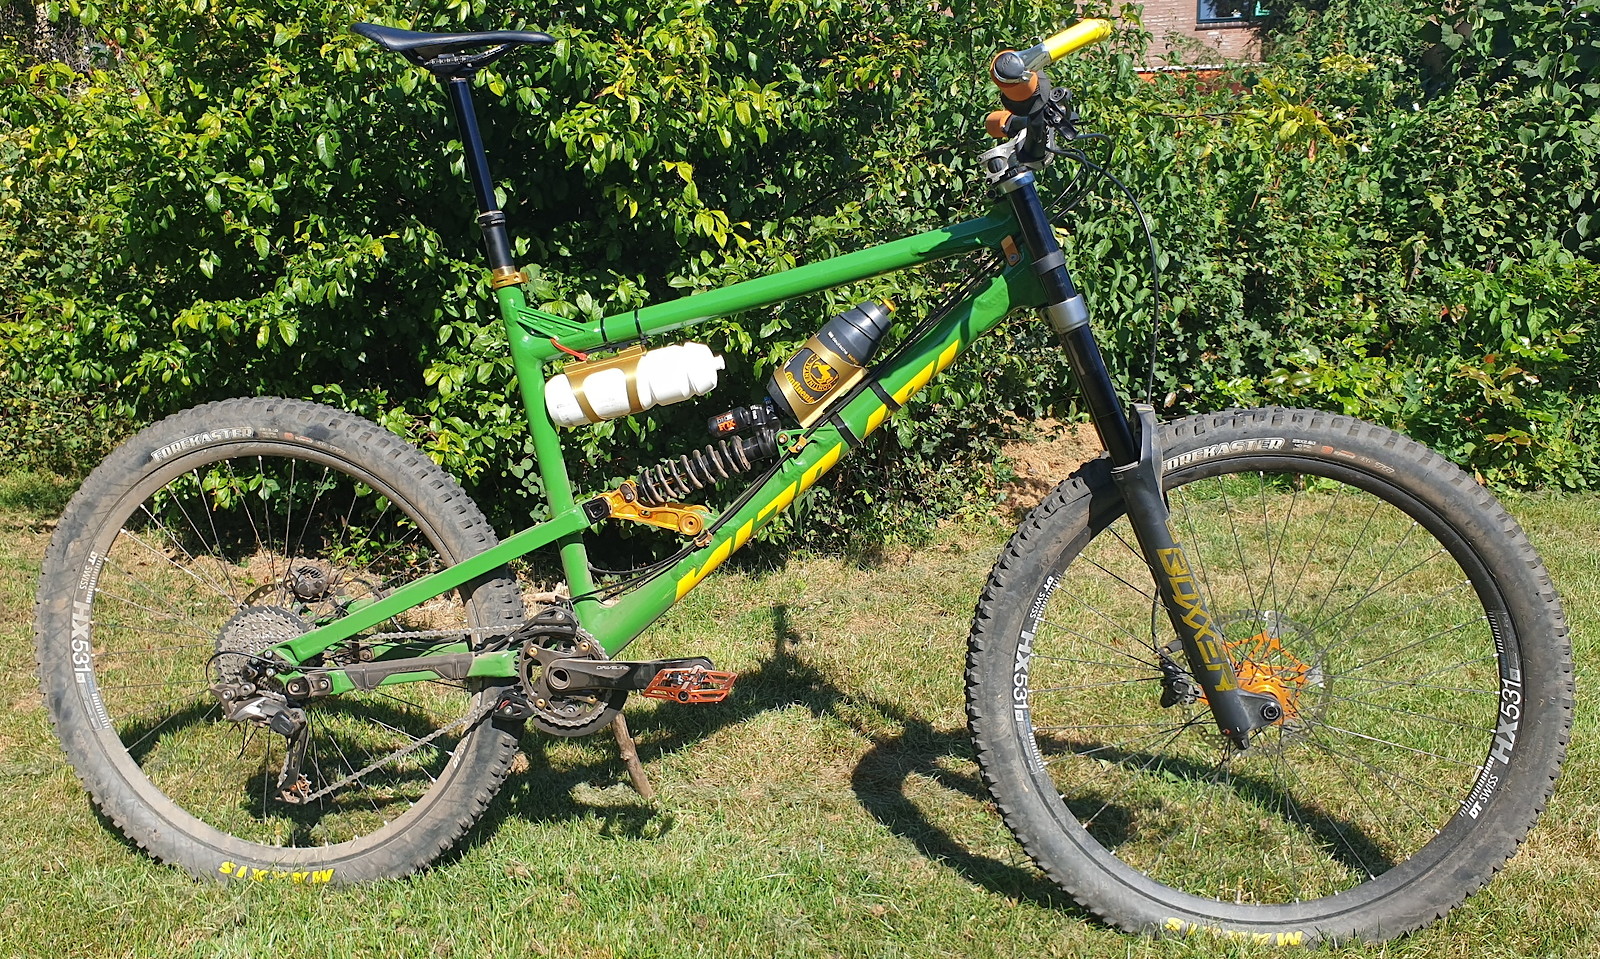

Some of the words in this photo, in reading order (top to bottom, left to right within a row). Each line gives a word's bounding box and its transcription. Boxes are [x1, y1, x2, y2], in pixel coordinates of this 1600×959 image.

[785, 372, 816, 403] Continenta
[717, 421, 736, 432] FOX
[151, 426, 254, 462] FOREKASTER
[88, 551, 98, 565] DT
[79, 564, 93, 590] SWISS
[1043, 575, 1055, 591] DT
[1029, 591, 1045, 618] SWISS
[1156, 548, 1239, 692] BOXXER
[1468, 801, 1482, 820] DT
[1478, 774, 1499, 804] SWISS
[1164, 917, 1303, 946] MAXIS
